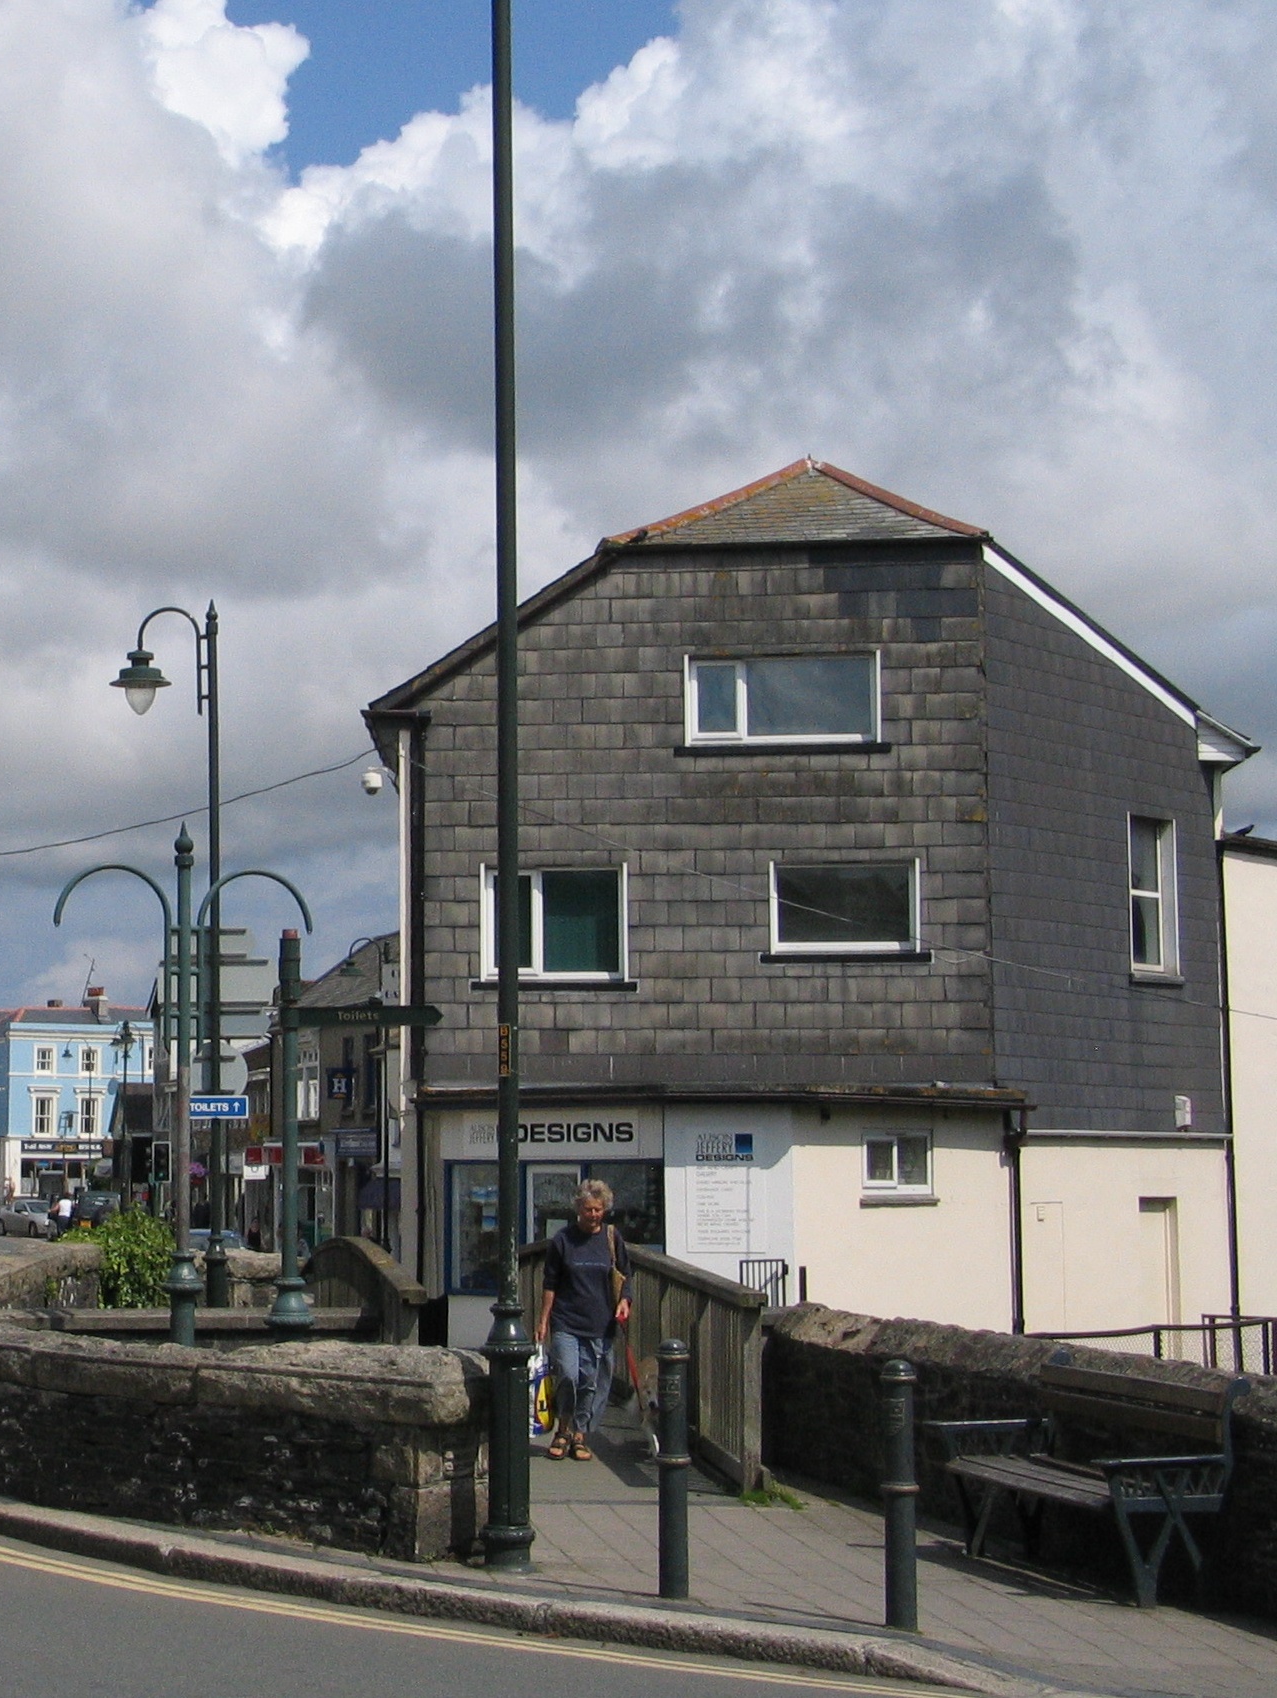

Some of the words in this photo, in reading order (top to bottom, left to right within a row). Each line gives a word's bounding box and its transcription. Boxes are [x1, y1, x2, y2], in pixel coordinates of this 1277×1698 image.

[337, 1010, 380, 1021] Toilets
[190, 1102, 230, 1112] TOILETS
[518, 1122, 634, 1143] DESIGNS
[696, 1132, 733, 1142] ALISON
[695, 1140, 734, 1154] JEFFERY
[696, 1154, 754, 1162] DESIGNS
